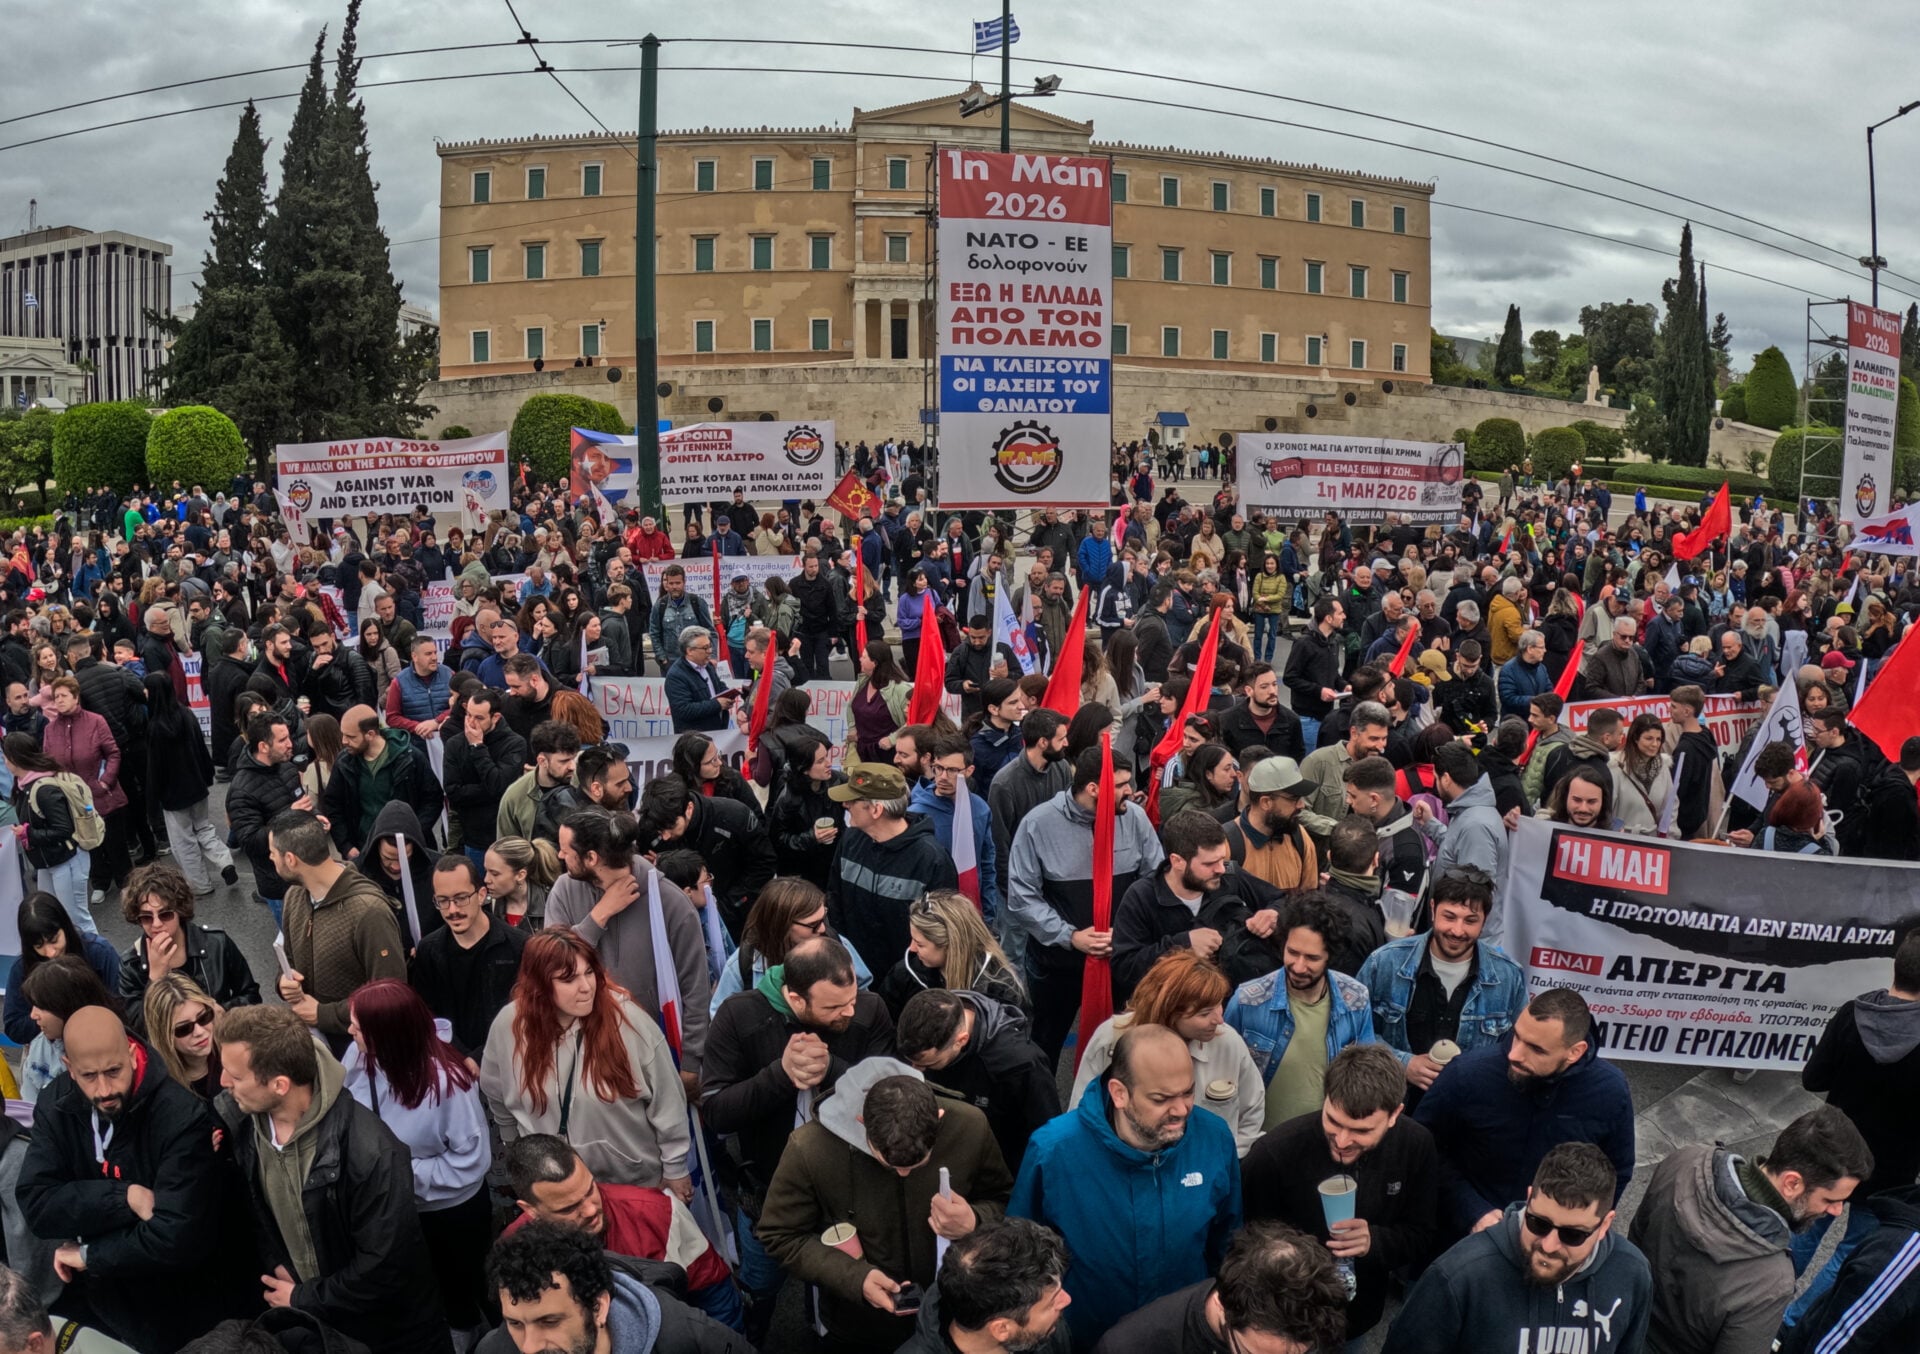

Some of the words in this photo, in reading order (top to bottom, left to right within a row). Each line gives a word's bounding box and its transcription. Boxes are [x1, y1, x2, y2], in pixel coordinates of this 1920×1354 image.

[985, 191, 1067, 220] 2026
[966, 232, 1039, 248] ΝΑΤΟ
[1065, 236, 1088, 252] ΕΕ
[967, 253, 1088, 275] δολοφονούν
[950, 282, 992, 302] ΕΞΩ
[1000, 283, 1013, 303] Η
[1022, 284, 1103, 307] ΕΛΛΑΔΑ
[950, 307, 1025, 324] ΑΠΟ
[1037, 308, 1102, 327] ΤΟΝ
[952, 327, 1102, 348] ΠΟΛΕΜΟ
[1865, 332, 1890, 354] 2026
[953, 358, 985, 373] ΝΑ
[993, 358, 1100, 375] ΚΛΕΙΣΟΥΝ
[953, 377, 976, 392] ΟΙ
[984, 378, 1054, 393] ΒΑΣΕΙΣ
[1062, 379, 1101, 394] ΤΟΥ
[1852, 371, 1868, 383] ΣΤΟ
[1870, 376, 1885, 388] ΛΑΟ
[1885, 379, 1895, 390] ΤΗΣ
[1851, 383, 1895, 401] ΠΑΛΑΙΣΤΙΝΗΣ
[977, 397, 1077, 413] ΘΑΝΑΤΟΥ
[1848, 408, 1859, 419] Να
[674, 430, 728, 442] ΧΡΟΝΙΑ
[328, 443, 360, 457] MAY
[364, 441, 394, 454] DAY
[399, 441, 441, 453] 2026
[666, 443, 679, 452] ΤΗ
[683, 442, 732, 452] ΓΕΝΝΗΣΗ
[1265, 442, 1272, 450] Ο
[1273, 442, 1308, 451] ΧΡΟΝΟΣ
[1310, 444, 1328, 452] ΜΑΣ
[1329, 445, 1342, 453] ΓΙΑ
[1344, 445, 1373, 454] ΑΥΤΟΥΣ
[1374, 446, 1394, 456] ΕΙΝΑΙ
[1395, 448, 1422, 458] ΧΡΗΜΑ
[285, 462, 301, 474] WE
[302, 461, 334, 473] MARCH
[336, 460, 351, 471] ON
[354, 458, 376, 470] THE
[378, 456, 406, 469] PATH
[409, 455, 424, 467] OF
[426, 451, 496, 467] OVERTHROW
[667, 454, 712, 464] ΦΙΝΤΕΛ
[716, 453, 765, 462] ΚΑΣΤΡΟ
[679, 475, 700, 484] ΤΗΣ
[703, 473, 746, 483] ΚΟΥΒΑΣ
[749, 472, 778, 482] ΕΙΝΑΙ
[781, 471, 793, 481] ΟΙ
[797, 470, 824, 481] ΛΑΟΙ
[1316, 463, 1332, 473] ΓΙΑ
[1334, 463, 1359, 474] ΕΜΑΣ
[1361, 464, 1382, 475] ΕΙΝΑΙ
[1383, 465, 1390, 474] Η
[334, 477, 395, 493] AGAINST
[400, 475, 435, 489] WAR
[661, 487, 704, 497] ΠΑΣΟΥΝ
[707, 485, 732, 494] ΤΩΡΑ
[750, 483, 822, 494] ΑΠΟΚΛΕΙΣΜΟΙ
[1316, 481, 1337, 502] 1η
[1341, 482, 1375, 500] ΜΑΗ
[1376, 483, 1417, 501] 2026
[320, 496, 347, 511] AND
[351, 490, 454, 508] EXPLOITATION
[1261, 508, 1292, 519] ΚΑΜΙΑ
[1294, 508, 1321, 519] ΘΥΣΙΑ
[1337, 510, 1346, 519] ΤΑ
[1347, 510, 1370, 520] ΚΕΡΔΗ
[1370, 510, 1384, 520] ΚΑΙ
[1412, 511, 1443, 521] ΟΛΕΜΟΥΣ
[1443, 511, 1457, 520] ΤΟΥΣ
[806, 688, 853, 716] ΔΡΟΜ
[1709, 720, 1731, 747] ΠΟ
[1558, 839, 1591, 877] 1Η
[1599, 847, 1664, 888] ΜΑΗ
[1590, 898, 1605, 917] Η
[1609, 902, 1741, 935] ΠΡΩΤΟΜΑΓΙΑ
[1743, 918, 1787, 939] ΔΕΝ
[1787, 922, 1843, 945] ΕΙΝΑΙ
[1843, 925, 1897, 946] ΑΡΓΙΑ
[1538, 950, 1592, 972] ΕΙΝΑΙ
[1606, 955, 1787, 994] ΑΠΕΡΓΙΑ
[1529, 975, 1592, 993] Παλεύουμε
[1593, 985, 1634, 998] ενάντια
[1636, 988, 1660, 1000] στην
[1661, 991, 1741, 1007] εντατικοποίηση
[1743, 996, 1761, 1007] της
[1761, 999, 1809, 1011] εργασίας,
[1811, 1003, 1828, 1013] για
[1666, 1009, 1687, 1020] την
[1689, 1007, 1754, 1025] εβδομάδα.
[1597, 1021, 1670, 1054] ΑΤΕΙΟ
[1675, 1028, 1818, 1062] ΕΡΓΑΖΟΜΕΝ
